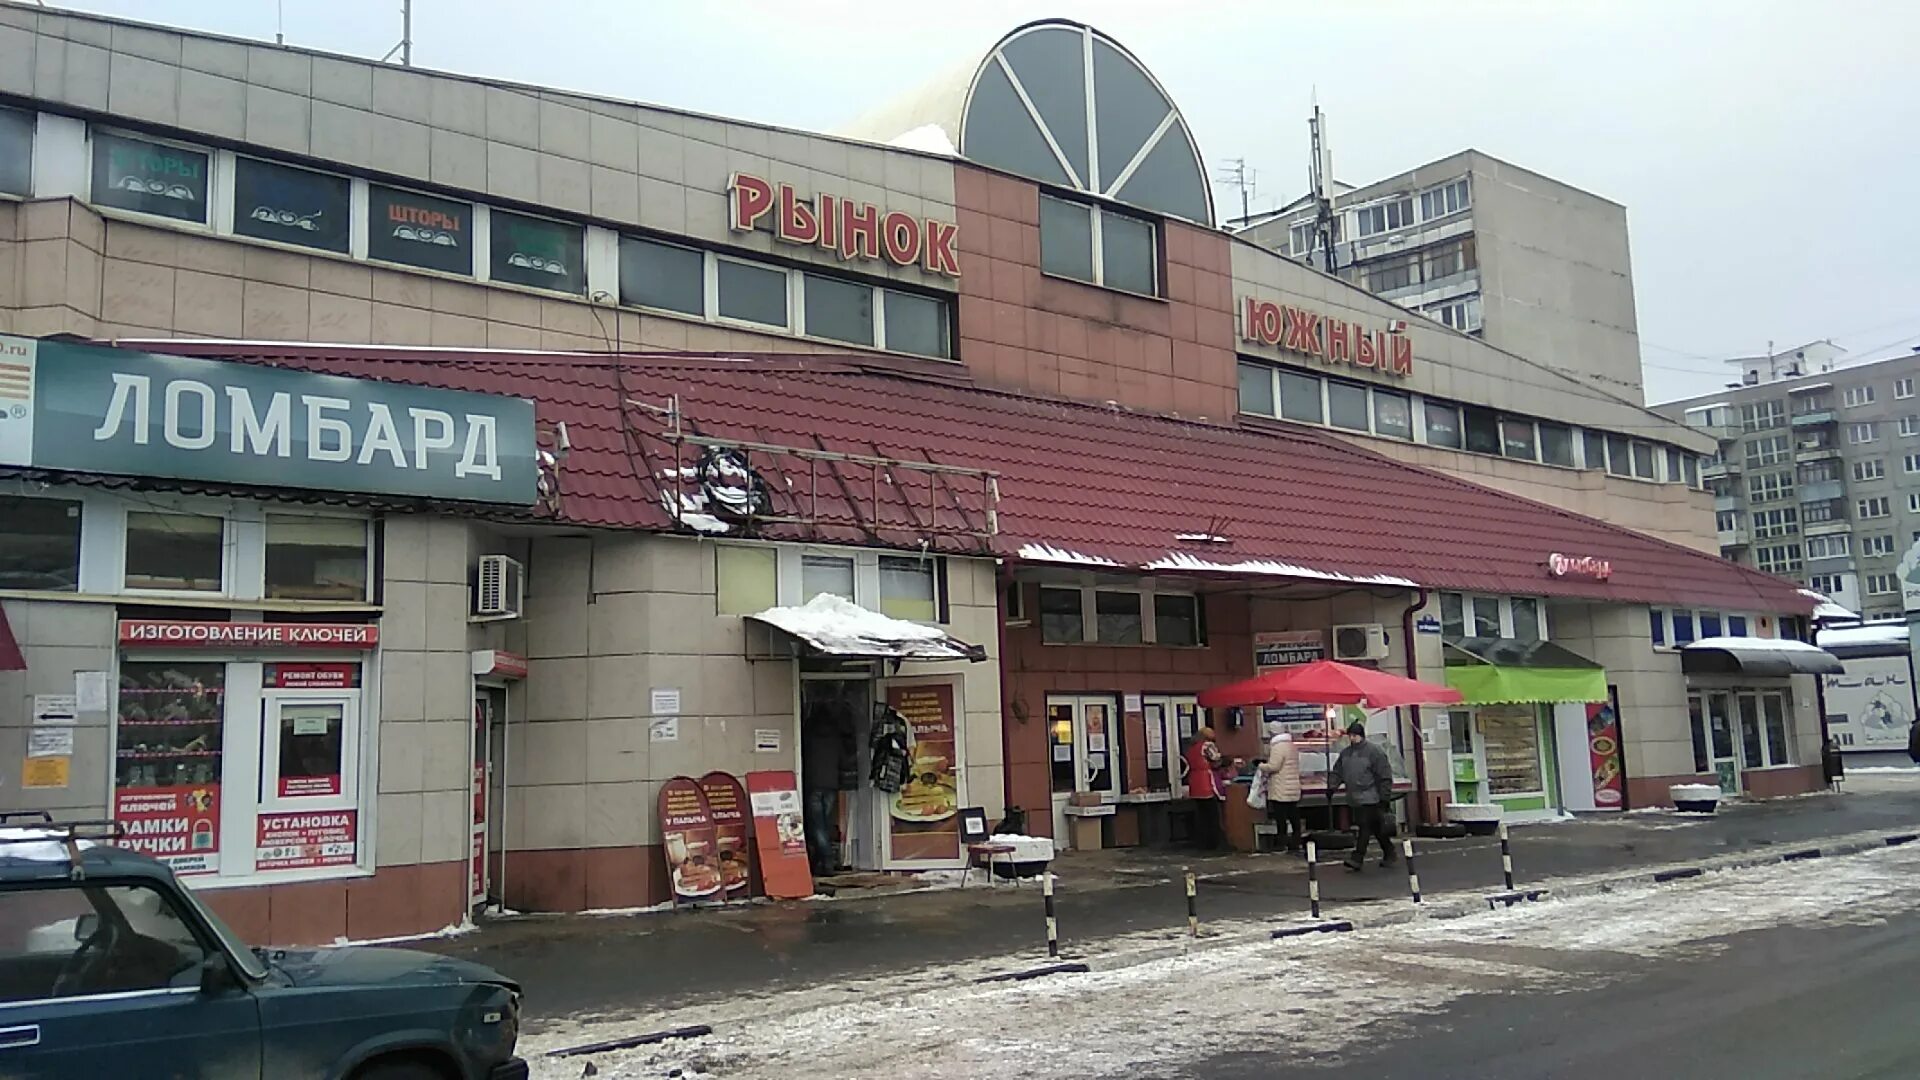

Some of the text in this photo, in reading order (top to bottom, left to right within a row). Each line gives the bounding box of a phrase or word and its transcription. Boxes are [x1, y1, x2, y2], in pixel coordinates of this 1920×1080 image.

[389, 204, 459, 231] ШТОРЫ
[728, 171, 962, 277] РЫНОК
[1241, 296, 1413, 376] ЮЖНЫЙ
[94, 373, 502, 481] ЛОМБАРД
[130, 625, 367, 642] ИЗГОТОВЛЕНИЕ КЛЮЧЕЙ
[283, 672, 344, 680] РЕМОНТ ОБУВИ
[262, 815, 349, 831] УСТАНОВКА
[118, 836, 187, 853] РУЧКИ
